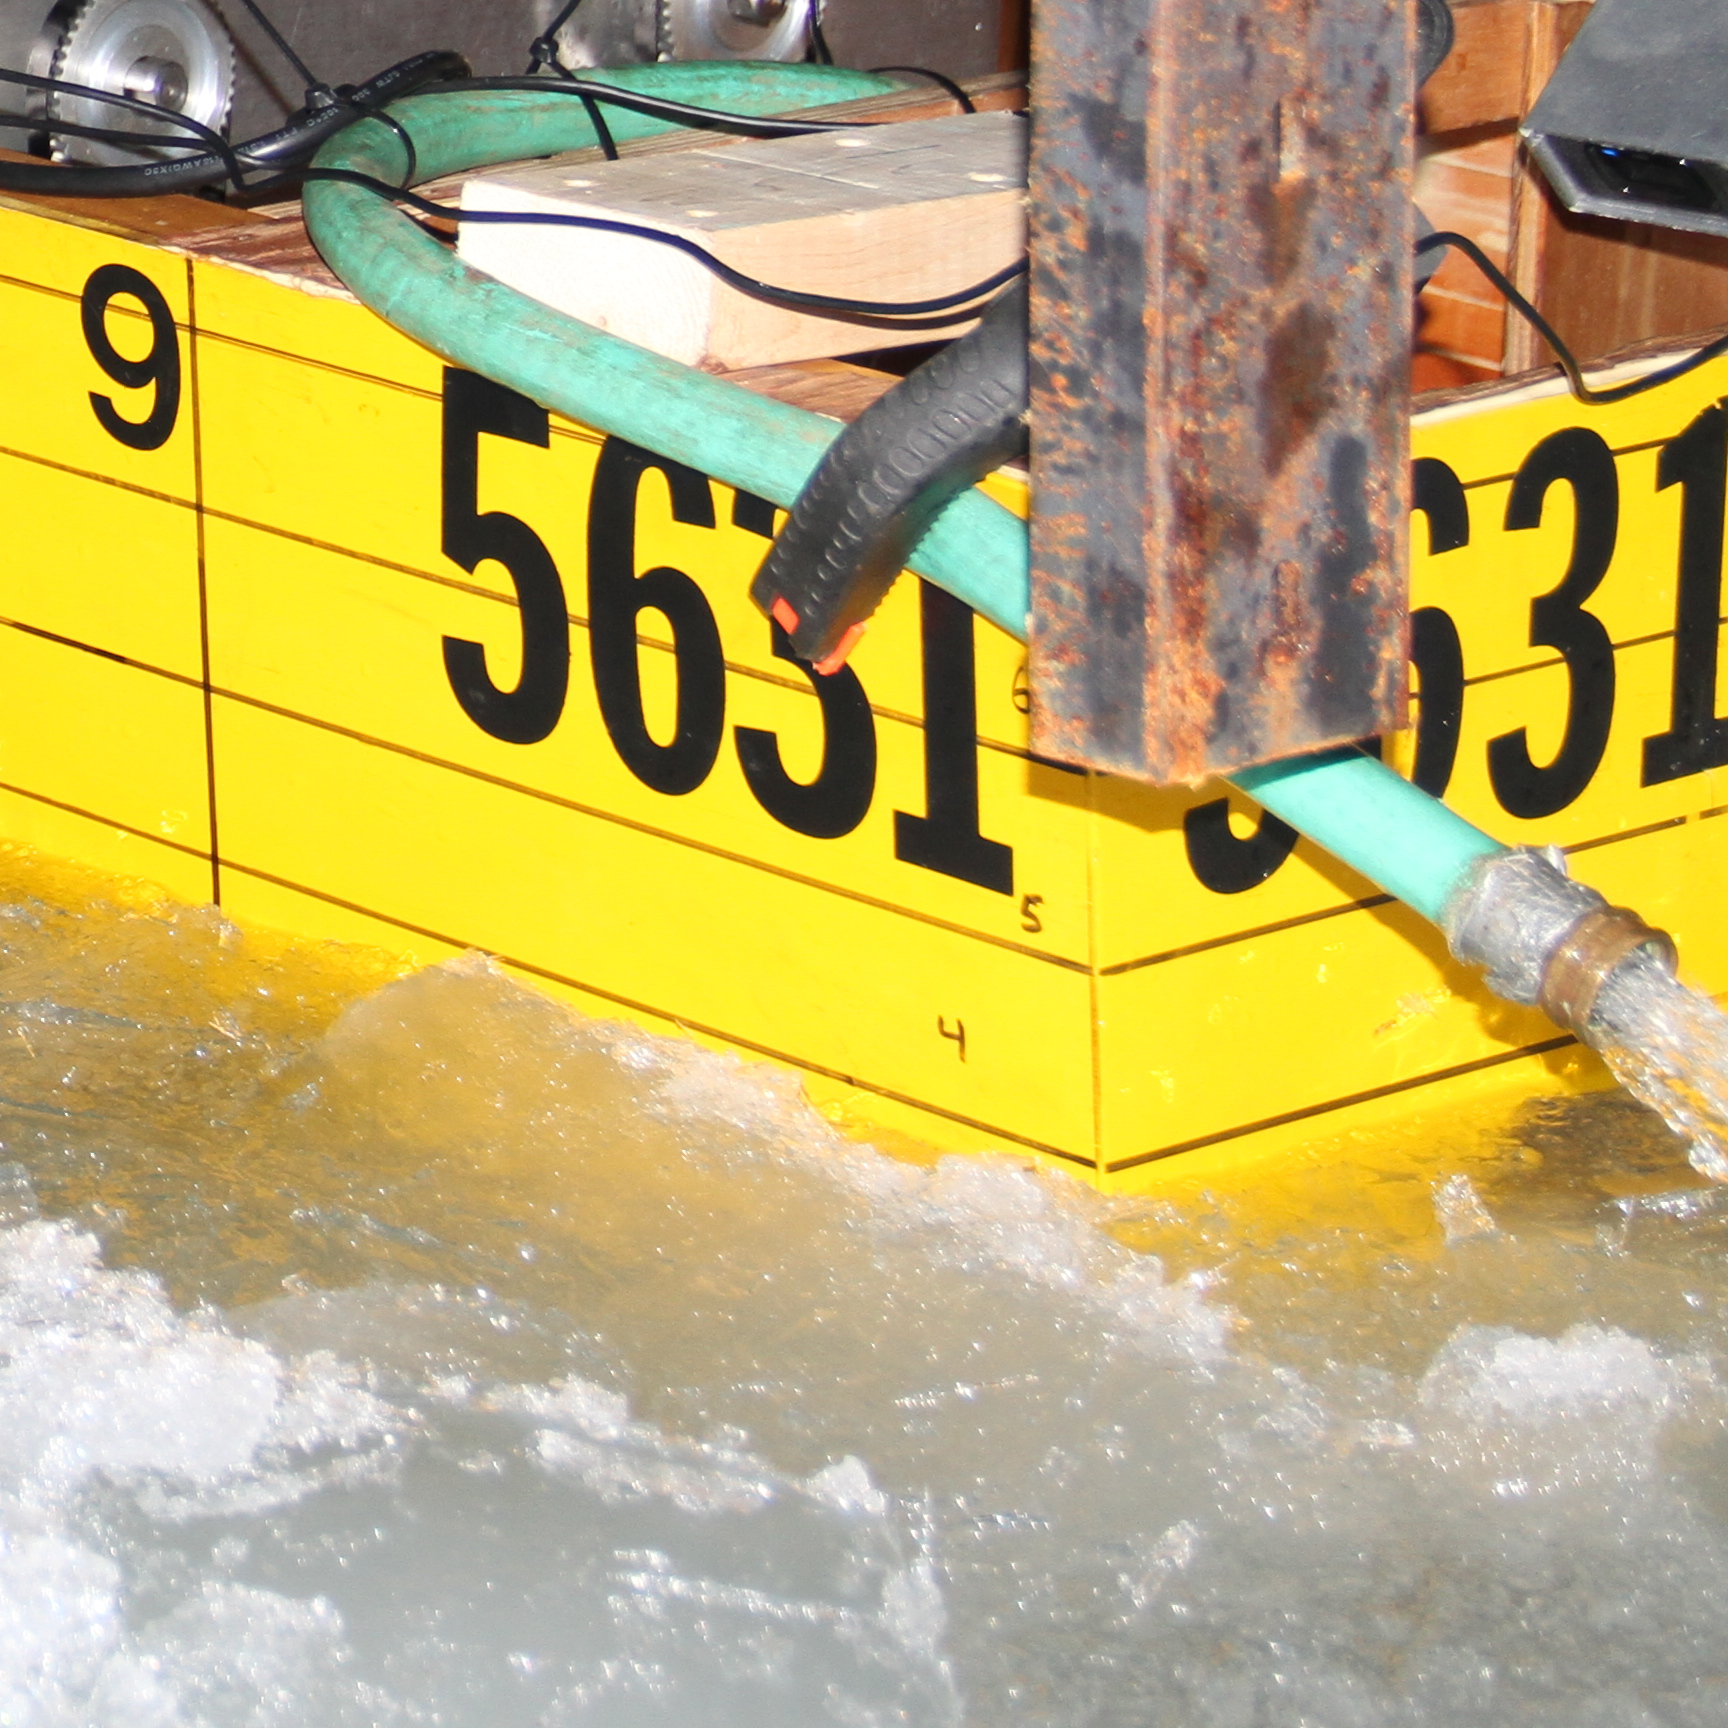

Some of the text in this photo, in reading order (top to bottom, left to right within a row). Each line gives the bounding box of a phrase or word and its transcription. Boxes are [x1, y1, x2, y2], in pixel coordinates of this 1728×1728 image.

[79, 263, 181, 452] 9
[1020, 892, 1045, 933] 5
[937, 1015, 966, 1062] 4
